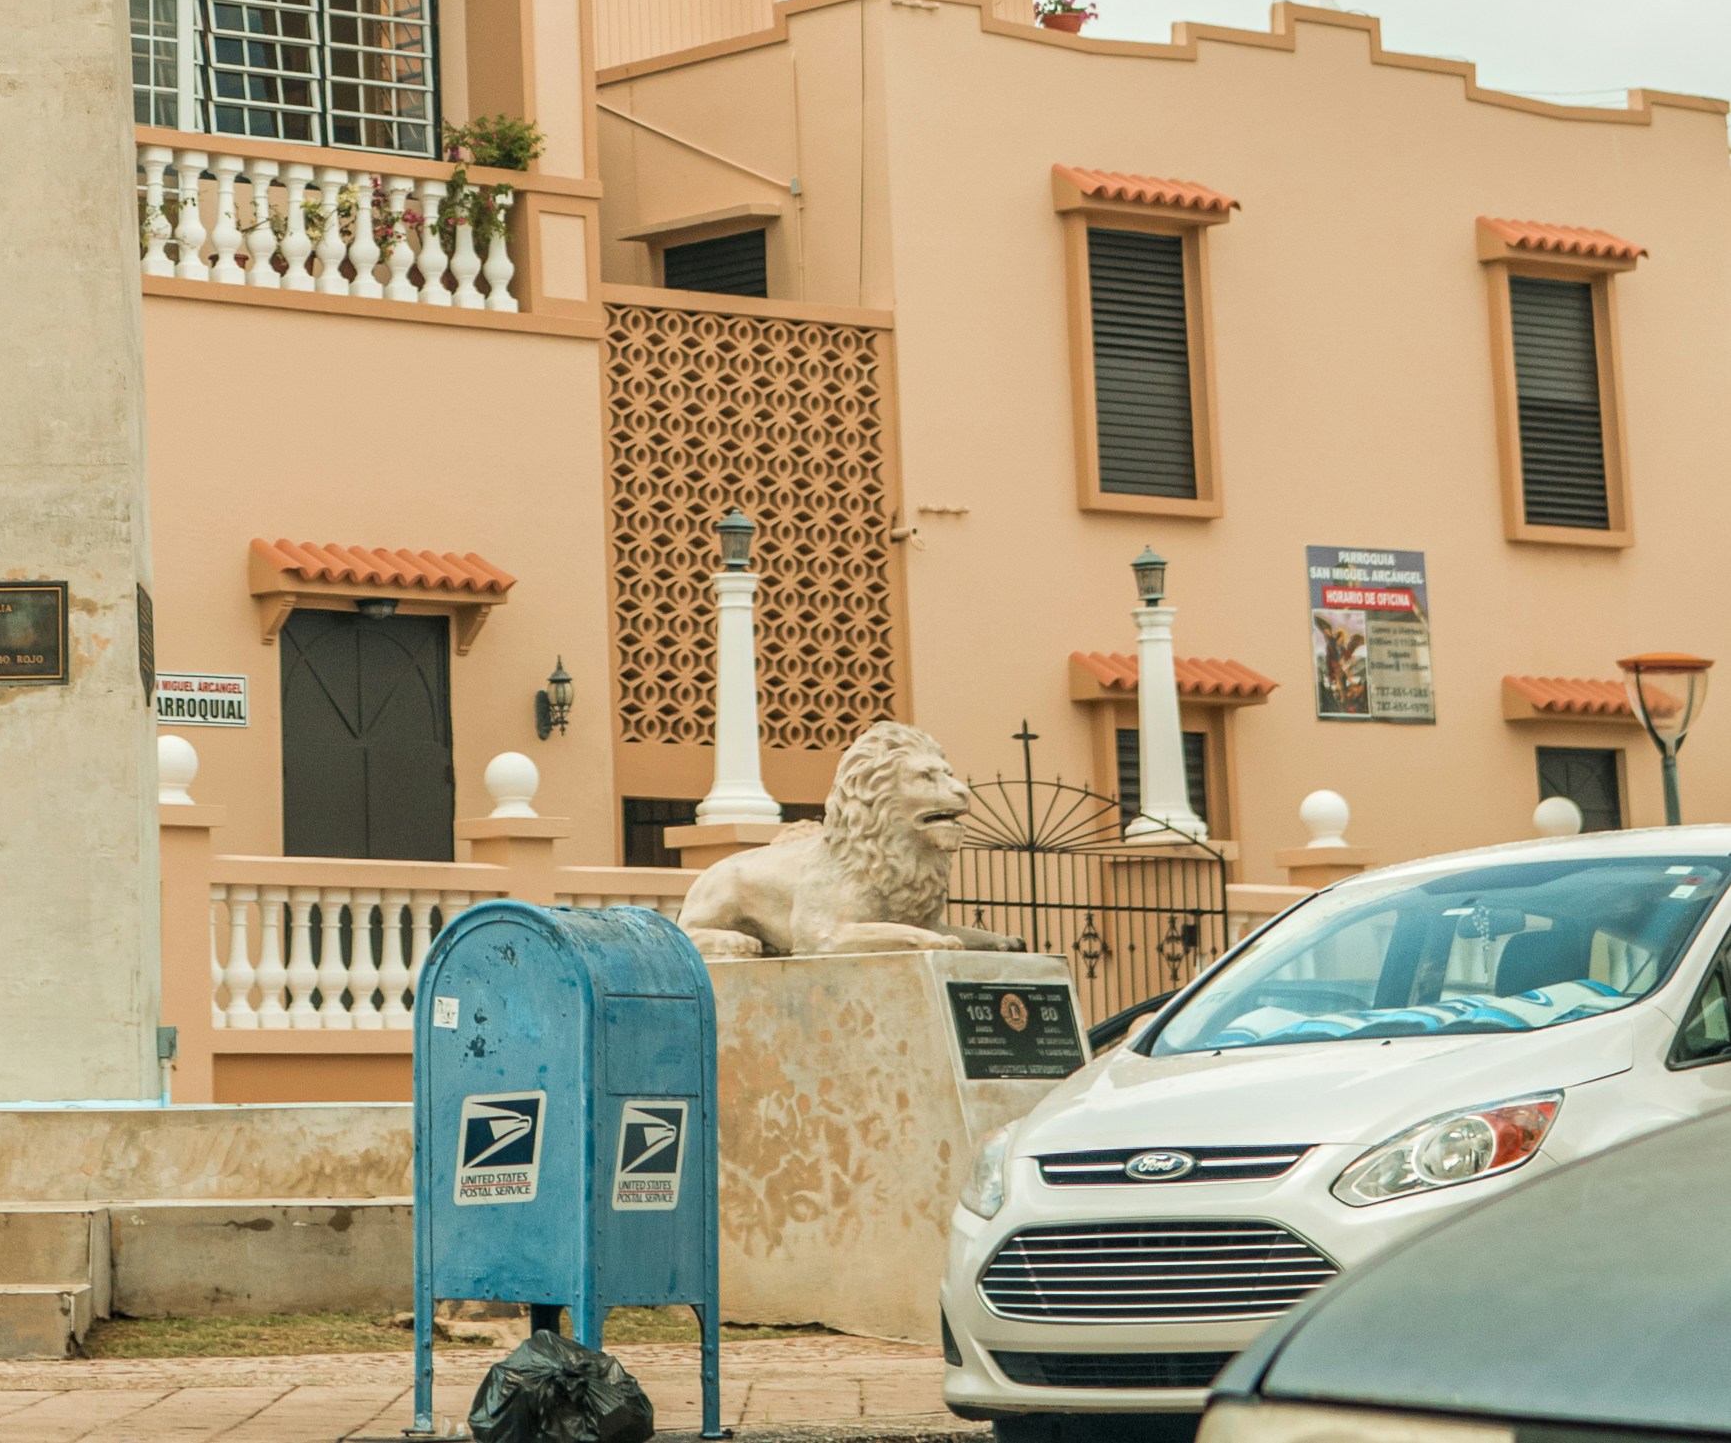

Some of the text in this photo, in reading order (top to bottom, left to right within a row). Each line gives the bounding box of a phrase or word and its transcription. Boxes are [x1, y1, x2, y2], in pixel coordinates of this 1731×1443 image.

[1338, 551, 1395, 566] PARROQUIA
[1310, 567, 1330, 580] SAN
[1332, 567, 1369, 582] MIGUEL
[1326, 590, 1410, 607] HORARIO DE OFICINA
[17, 654, 44, 664] ROJO
[162, 680, 194, 692] MIGUEL
[157, 697, 245, 720] ARROQUIAL
[966, 1005, 993, 1021] 103
[1138, 1154, 1176, 1172] Ford
[461, 1172, 528, 1185] UNITED STATES
[618, 1180, 672, 1190] UNITED STATES
[460, 1185, 531, 1198] POSTAL SERVICE
[617, 1194, 673, 1203] POSTAL SERVICE
